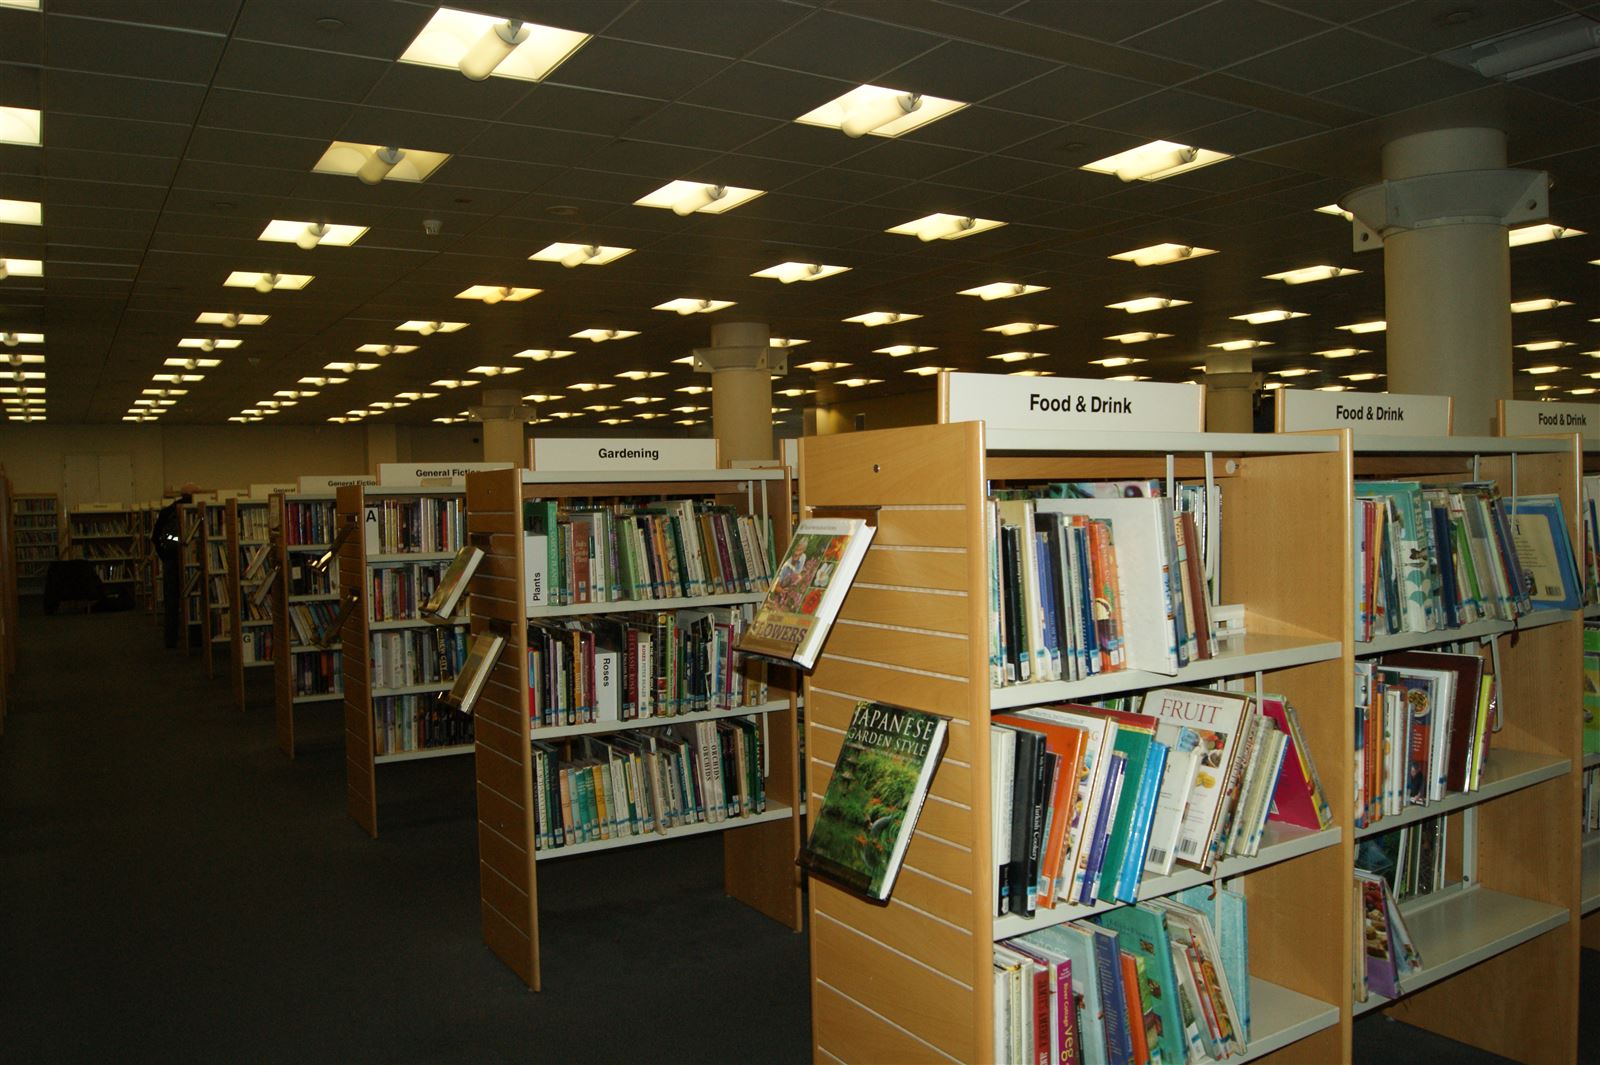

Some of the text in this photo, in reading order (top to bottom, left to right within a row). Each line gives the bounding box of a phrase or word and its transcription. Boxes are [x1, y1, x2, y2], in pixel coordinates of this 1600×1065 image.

[1030, 393, 1132, 414] Food & Drink
[1336, 405, 1404, 421] Food & Drink
[1538, 412, 1587, 427] Food & Drink
[598, 447, 659, 460] Gardening
[415, 469, 450, 477] General
[366, 510, 377, 522] A
[533, 572, 541, 601] Plants
[243, 634, 251, 643] G
[602, 658, 611, 687] Roses
[851, 705, 935, 741] JAPANESE
[1159, 697, 1222, 725] FRUIT
[847, 726, 928, 757] GARDEN STYLE
[703, 746, 712, 782] ORCHIDS
[711, 744, 720, 781] ORCHIDS
[1029, 804, 1042, 861] Turkish Cookery
[1060, 1024, 1074, 1062] veg
